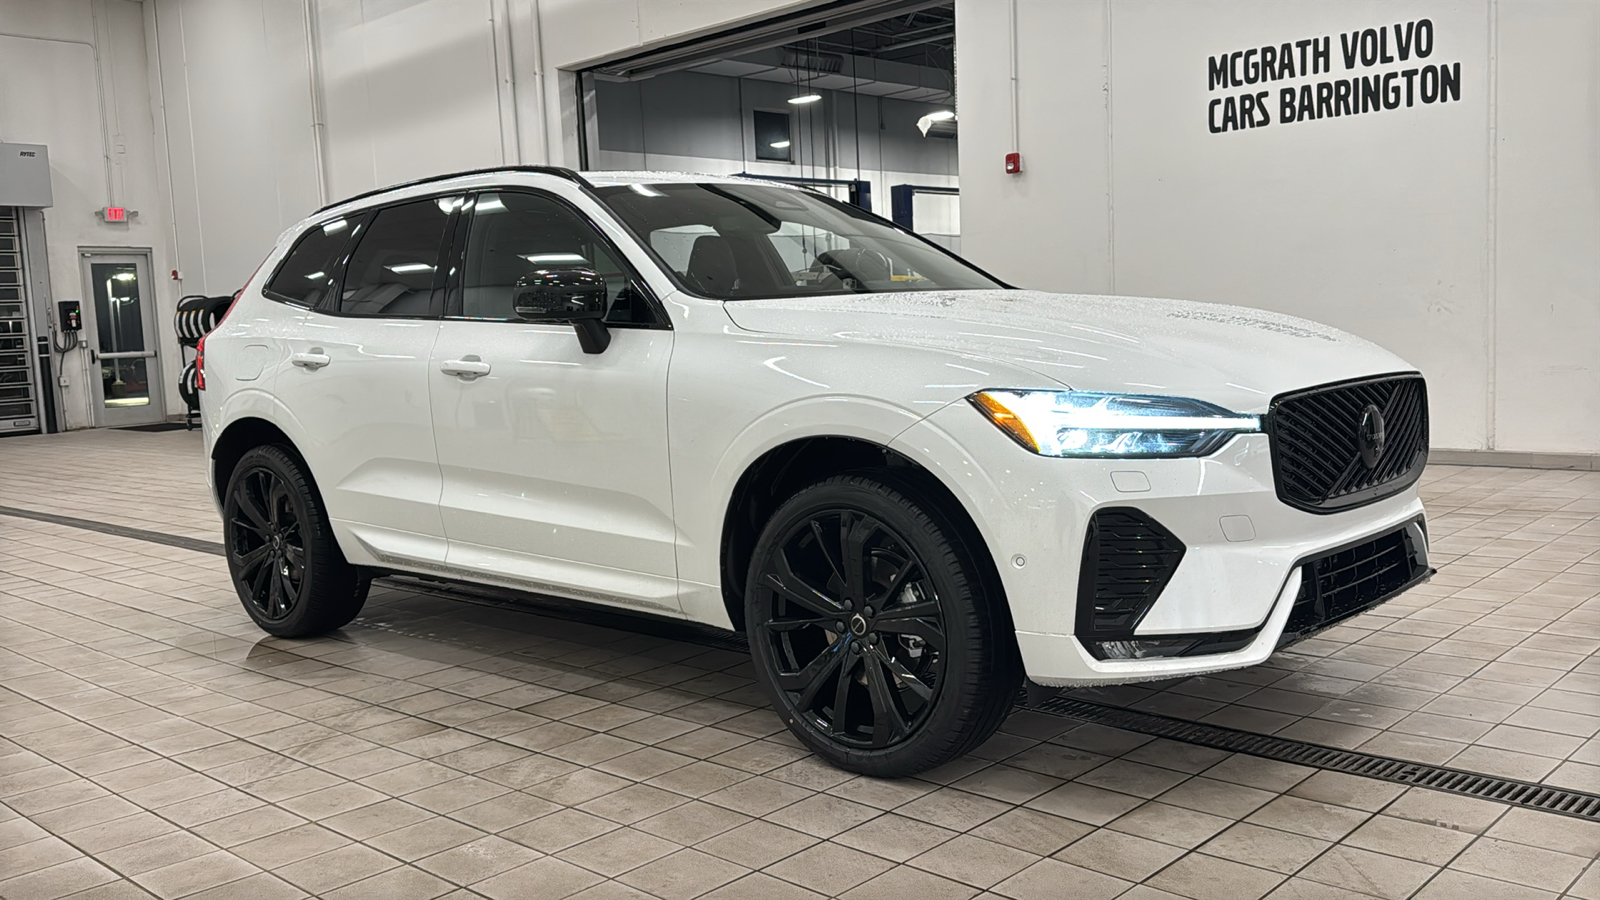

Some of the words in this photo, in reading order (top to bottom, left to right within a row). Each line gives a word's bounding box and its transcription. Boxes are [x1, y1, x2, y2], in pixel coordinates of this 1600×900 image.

[1208, 36, 1330, 91] MCGRATH
[1340, 19, 1433, 70] VOLVO
[1208, 91, 1270, 134] CARS
[1279, 62, 1461, 124] BARRINGTON
